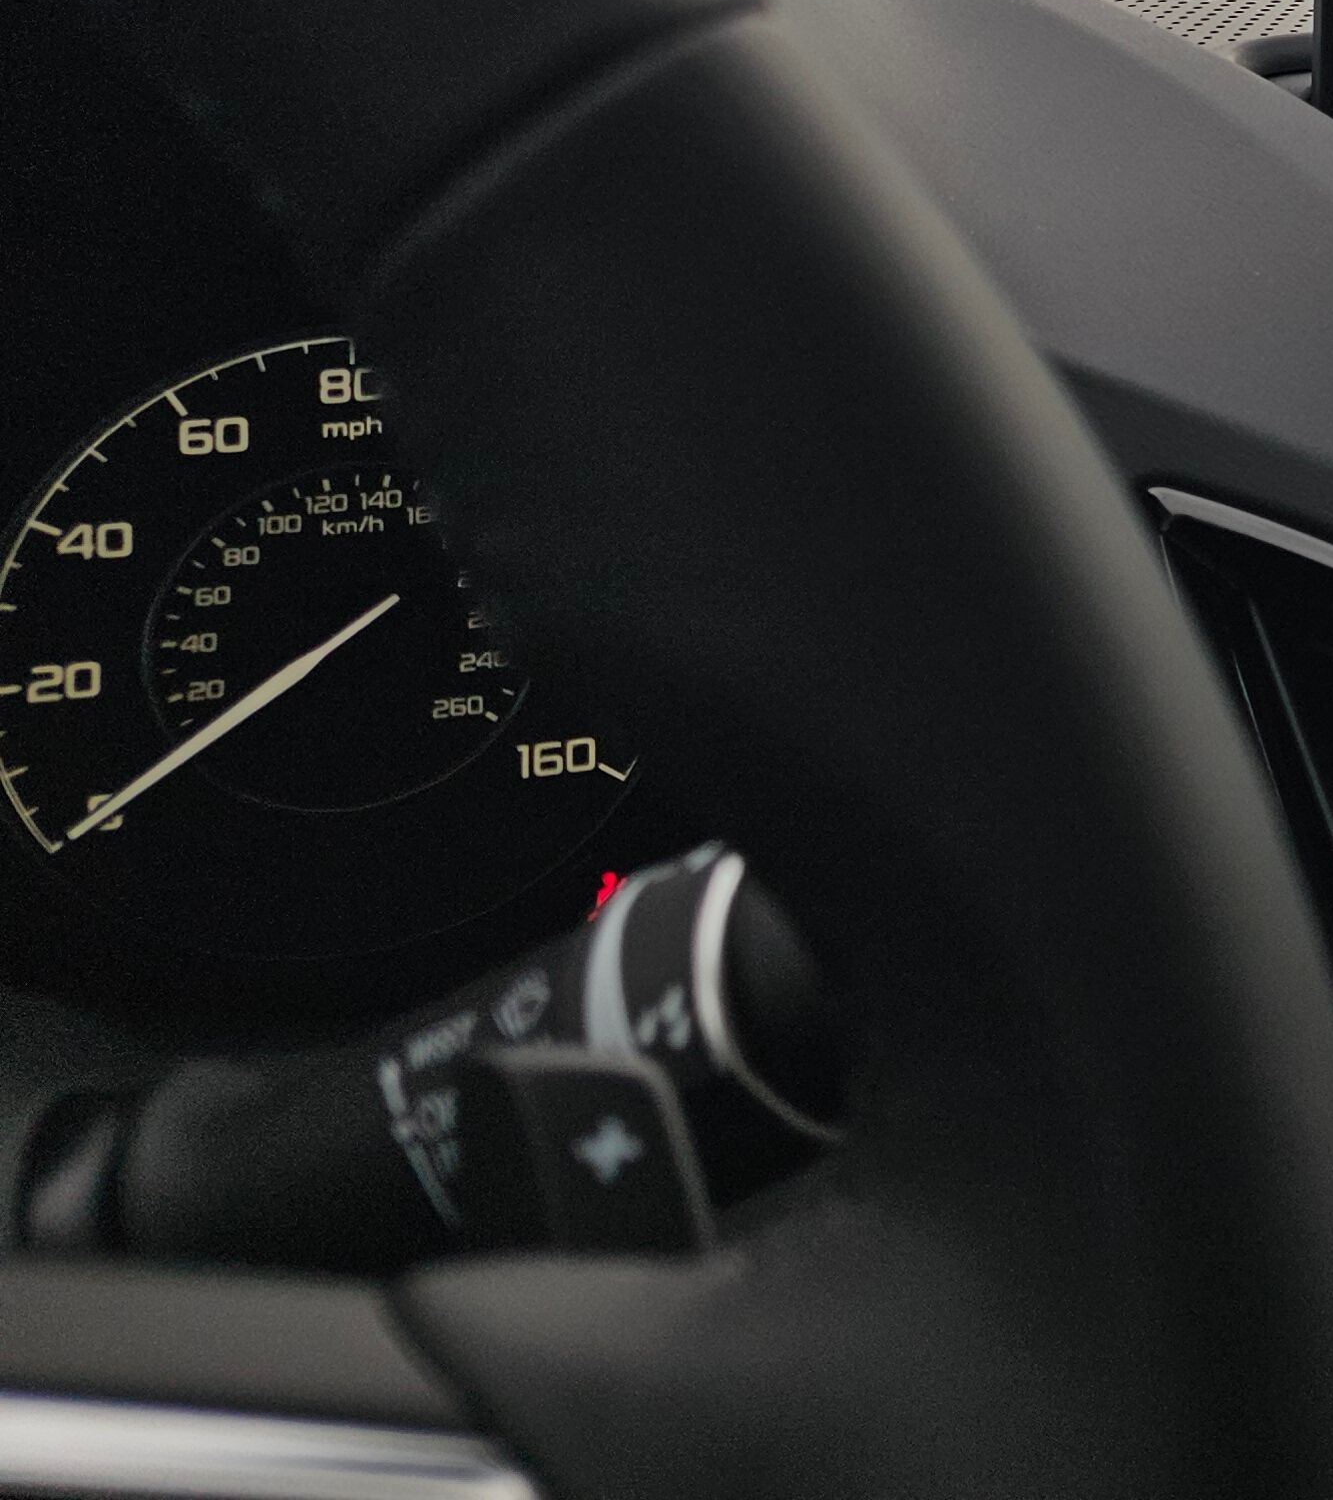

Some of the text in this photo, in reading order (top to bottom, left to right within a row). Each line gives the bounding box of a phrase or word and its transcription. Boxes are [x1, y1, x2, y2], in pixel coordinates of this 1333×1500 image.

[179, 417, 249, 455] 60
[322, 416, 382, 440] mph
[306, 493, 348, 514] 120
[360, 490, 402, 510] 140
[257, 515, 302, 535] 100
[322, 515, 384, 535] km/h
[407, 506, 432, 526] 16
[57, 522, 133, 560] 40
[224, 546, 260, 567] 80
[194, 586, 231, 606] 60
[180, 632, 217, 653] 40
[27, 661, 101, 703] 20
[187, 679, 225, 700] 20
[432, 695, 483, 718] 260
[517, 736, 596, 778] 160
